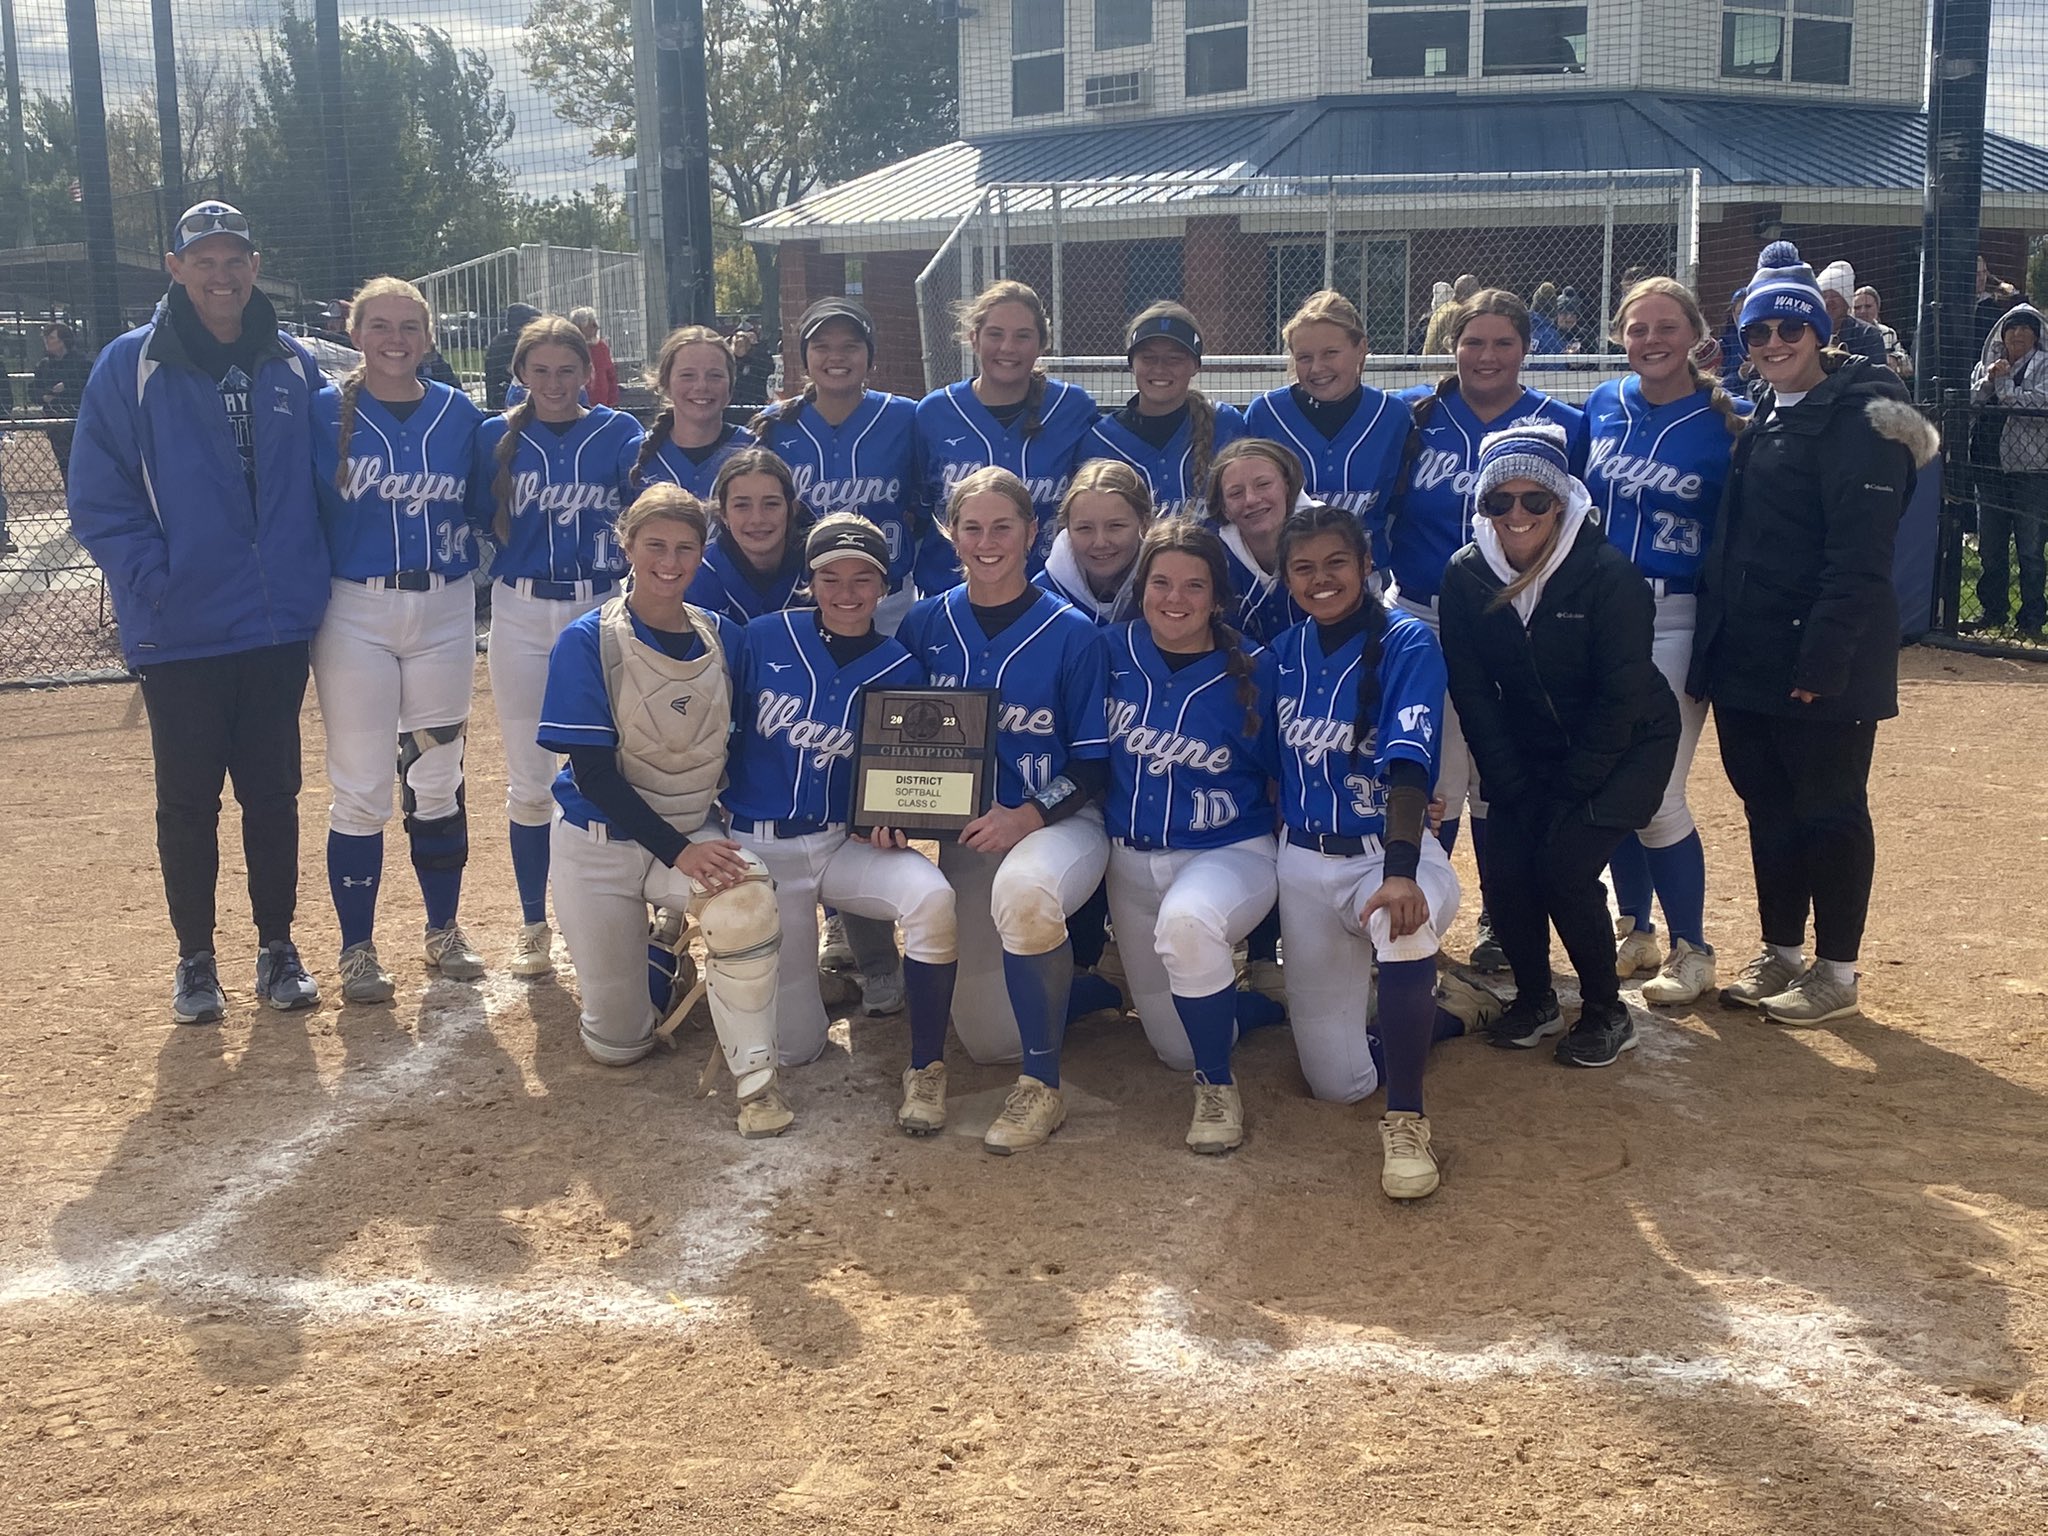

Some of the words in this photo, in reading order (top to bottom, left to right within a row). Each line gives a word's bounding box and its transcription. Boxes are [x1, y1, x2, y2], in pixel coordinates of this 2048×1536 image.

[1774, 295, 1814, 314] WAYNE
[339, 454, 467, 518] Wayne
[1584, 436, 1703, 500] Wayne
[1652, 509, 1702, 557] 23
[756, 688, 856, 771] Way
[890, 715, 903, 725] 20
[942, 716, 956, 727] 23
[1106, 697, 1233, 776] Wayne
[880, 745, 965, 759] CHAMPION
[895, 787, 942, 798] SOFTBALL
[896, 775, 943, 786] DISTRICT
[1016, 752, 1053, 799] 11
[897, 798, 928, 808] CLASS
[929, 799, 937, 809] C
[1188, 787, 1240, 832] 10
